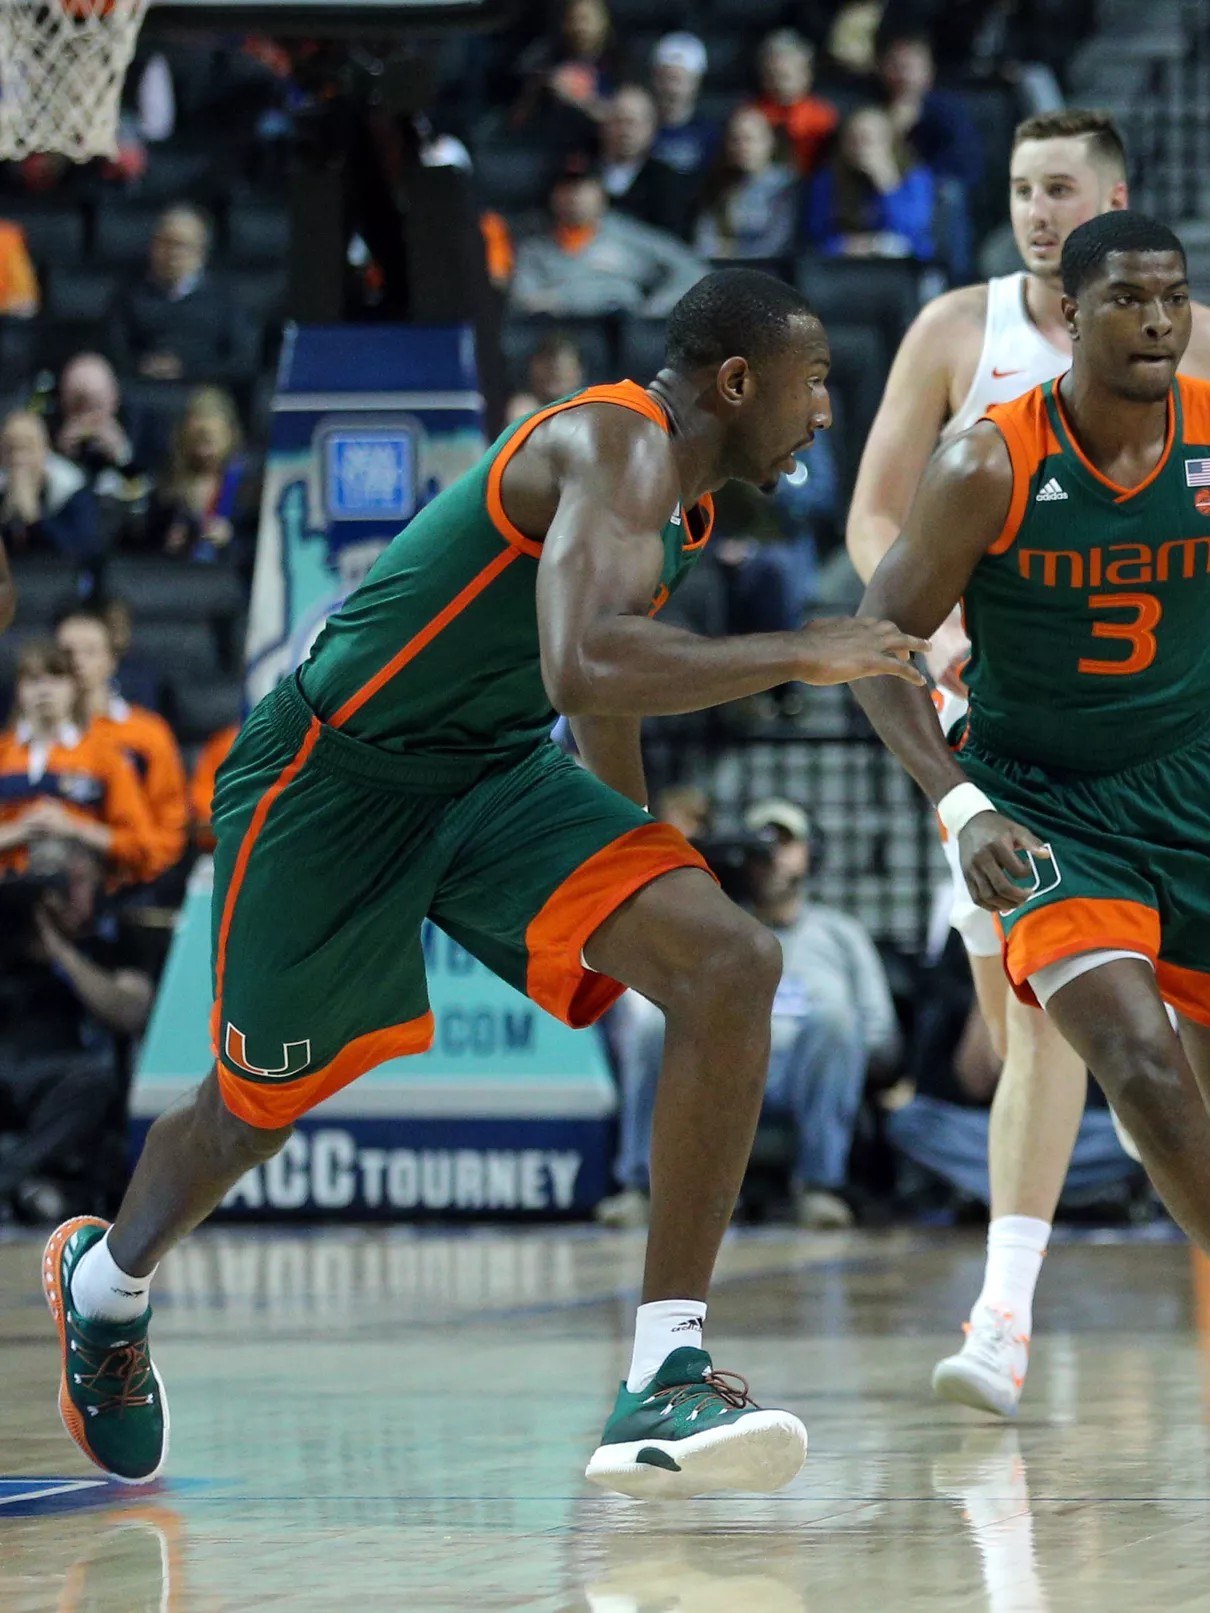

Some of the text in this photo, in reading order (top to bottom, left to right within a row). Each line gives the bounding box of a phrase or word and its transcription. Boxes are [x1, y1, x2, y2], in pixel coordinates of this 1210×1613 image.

[1036, 491, 1068, 502] adidas
[1077, 592, 1163, 676] 3
[225, 1021, 310, 1077] U
